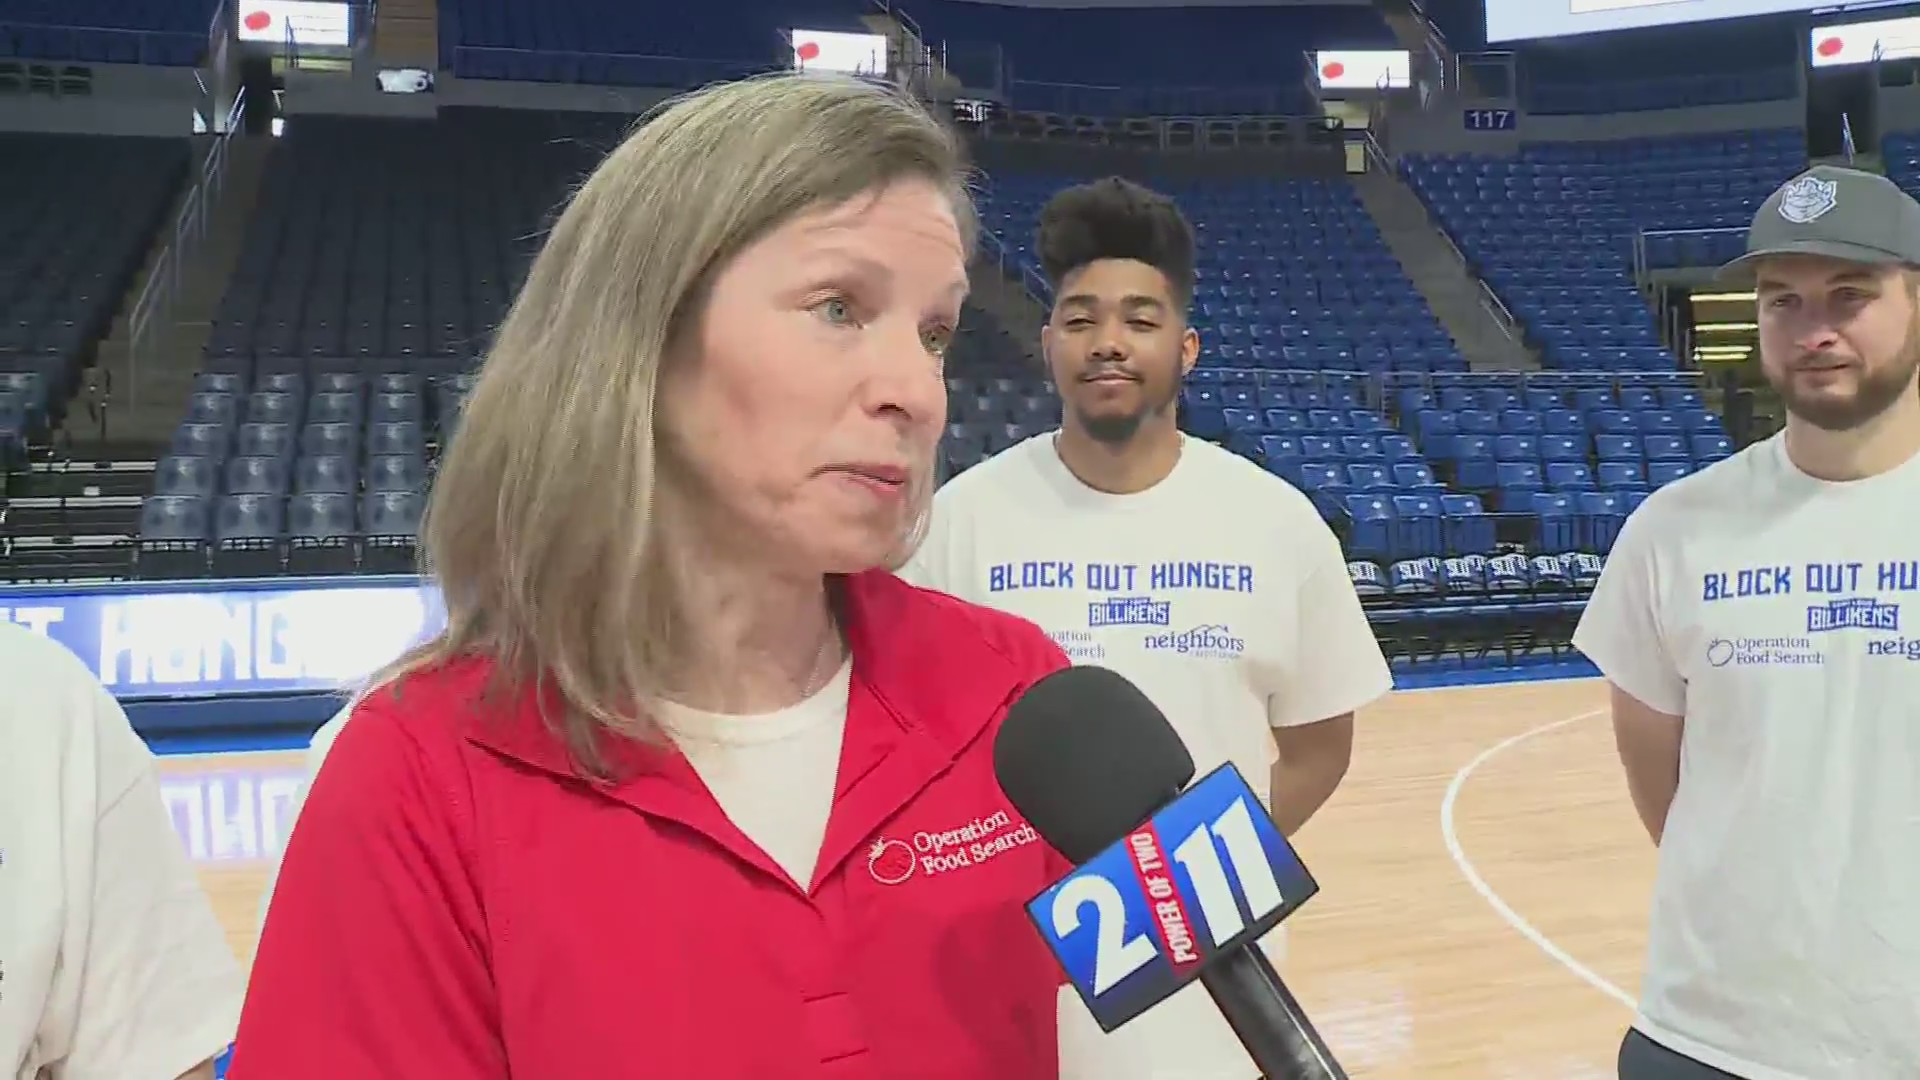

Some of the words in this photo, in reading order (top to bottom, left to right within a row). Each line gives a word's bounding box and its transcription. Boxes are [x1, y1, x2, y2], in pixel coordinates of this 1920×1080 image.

[1471, 111, 1509, 128] 117
[989, 561, 1073, 592] BLOCK
[1087, 563, 1137, 591] OUT
[1151, 562, 1253, 593] HUNGER
[1703, 567, 1791, 601] BLOCK
[1806, 563, 1863, 593] OUT
[1090, 602, 1168, 625] BILLIKENS
[1809, 605, 1896, 630] BILLIKENS
[1144, 629, 1245, 653] neighbors
[1735, 636, 1810, 652] Operation
[1736, 651, 1770, 665] Food
[1773, 651, 1824, 665] Search
[913, 809, 1011, 853] Operation
[920, 848, 972, 876] Food
[969, 822, 1038, 863] Search
[1130, 832, 1164, 874] TWO
[1145, 875, 1173, 899] OF
[1173, 794, 1284, 949] 11
[1051, 873, 1160, 998] 2
[1155, 899, 1198, 964] POWER
